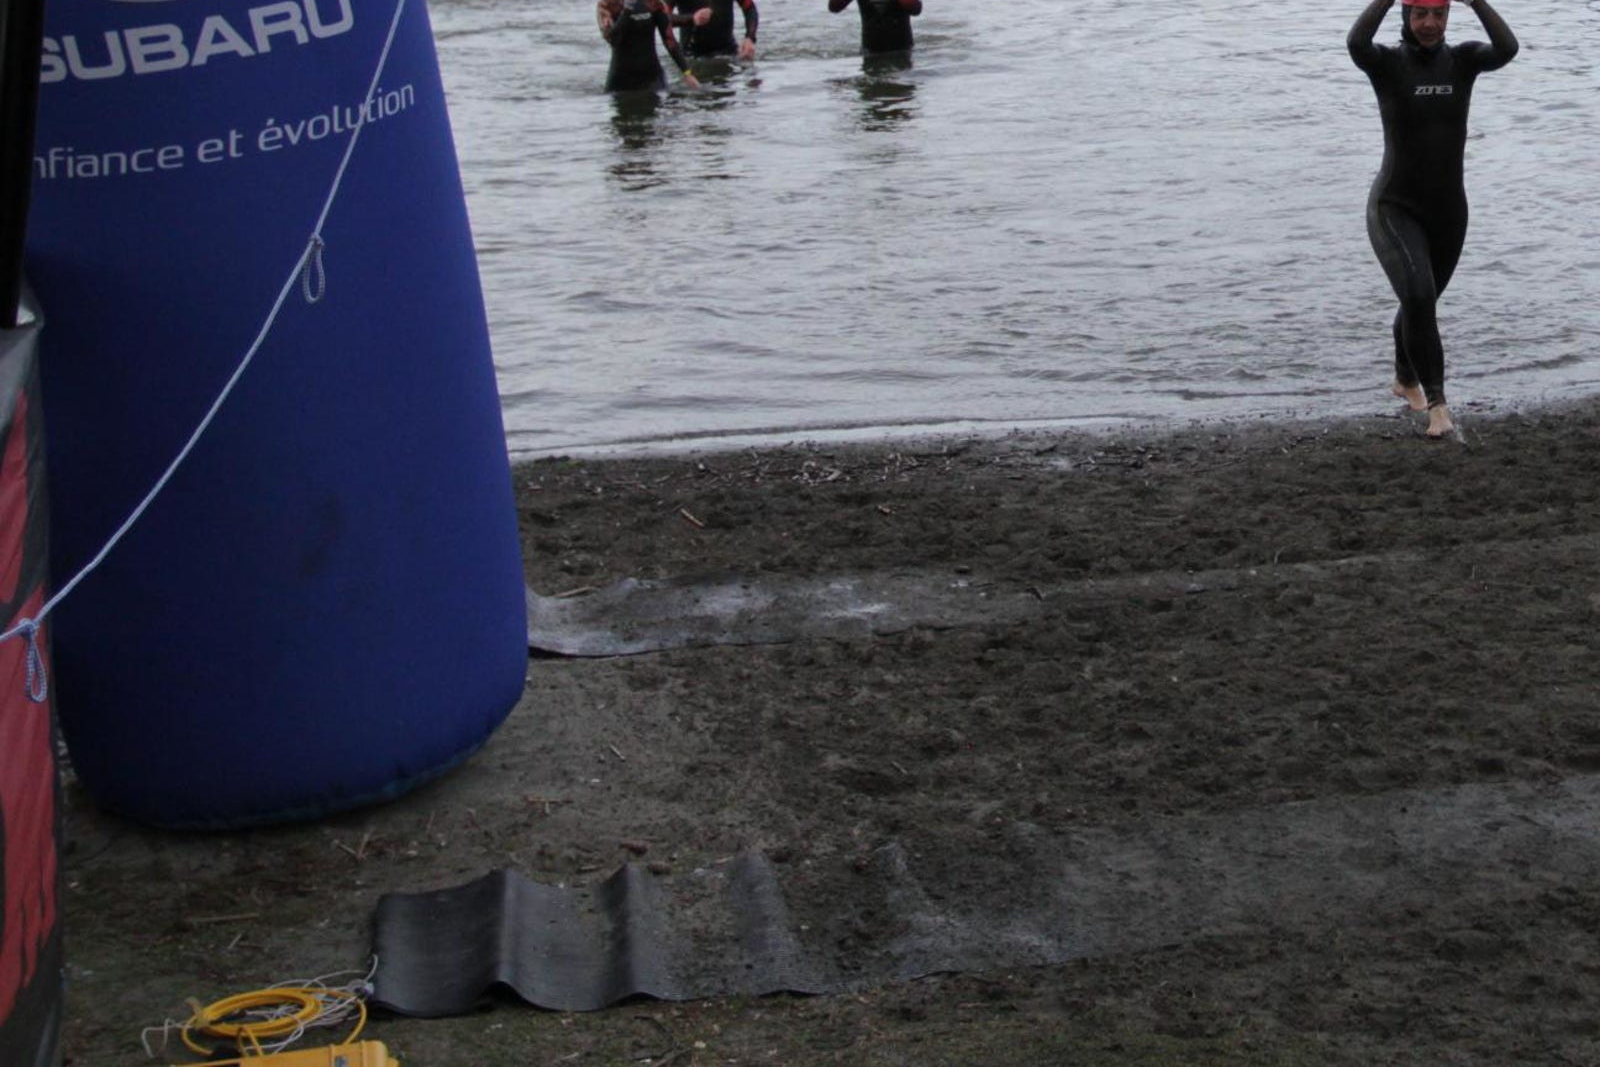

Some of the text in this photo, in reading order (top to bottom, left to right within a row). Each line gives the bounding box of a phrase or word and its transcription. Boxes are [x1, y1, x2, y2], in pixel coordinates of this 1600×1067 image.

[33, 83, 415, 179] nfiance et évolution
